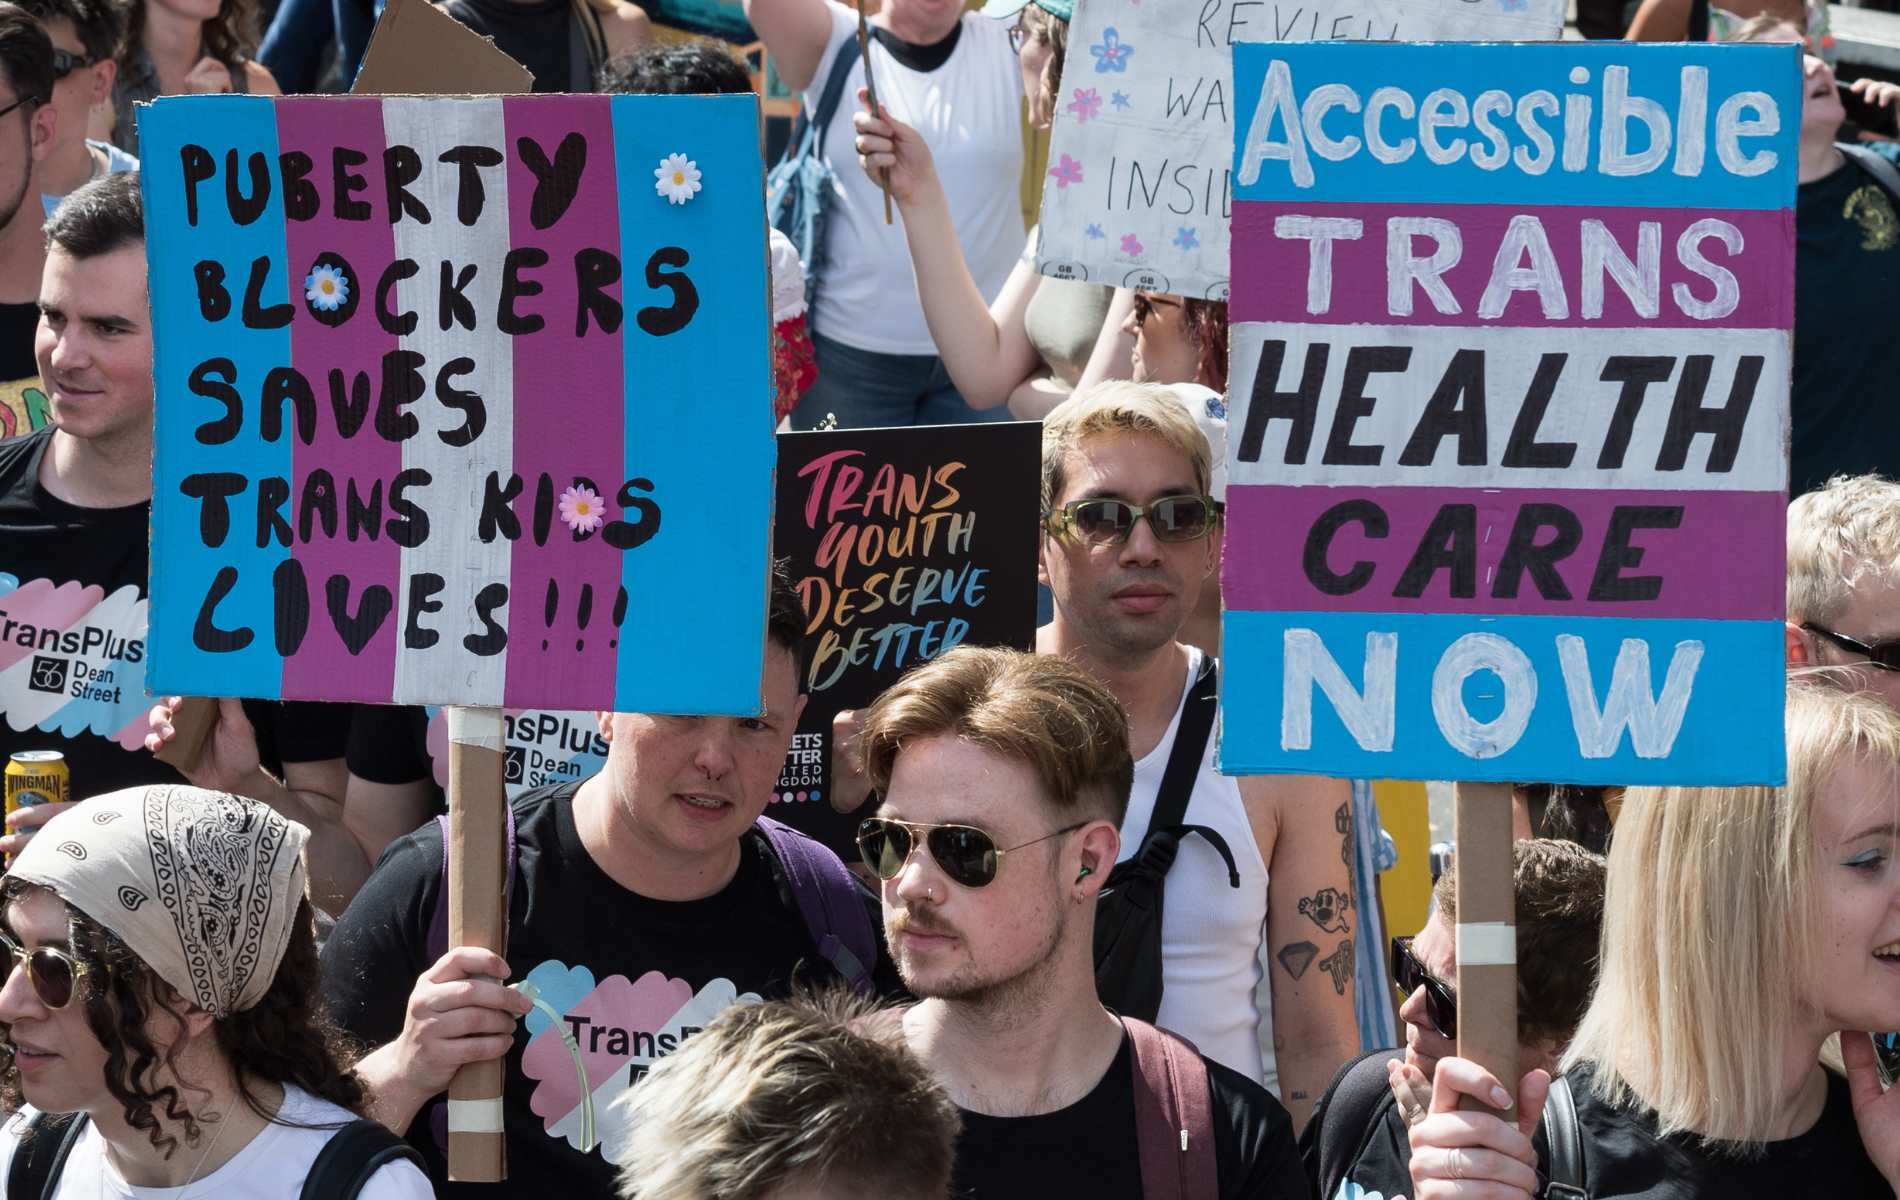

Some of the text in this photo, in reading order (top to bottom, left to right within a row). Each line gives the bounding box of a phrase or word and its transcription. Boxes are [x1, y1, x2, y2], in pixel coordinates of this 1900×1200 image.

[1239, 60, 1780, 188] Accessible
[180, 131, 588, 231] PUBERTY
[194, 246, 699, 338] BLOCKERS
[1274, 214, 1744, 320] TRANS
[188, 349, 487, 448] SAVES
[1237, 340, 1764, 473] HEALTH
[180, 468, 433, 548] TRANS
[798, 450, 966, 529] TRANS
[815, 511, 976, 588] YOUTH
[1302, 499, 1685, 602] CARE
[795, 561, 990, 635] DESERVE
[71, 681, 121, 704] Street
[73, 661, 114, 683] Dean
[1280, 628, 1704, 759] NOW
[504, 713, 610, 757] nsPlus
[530, 749, 581, 776] Dean
[783, 764, 822, 776] ITED
[789, 733, 823, 749] ETS
[775, 775, 822, 787] GDOM
[563, 1015, 703, 1058] Trans
